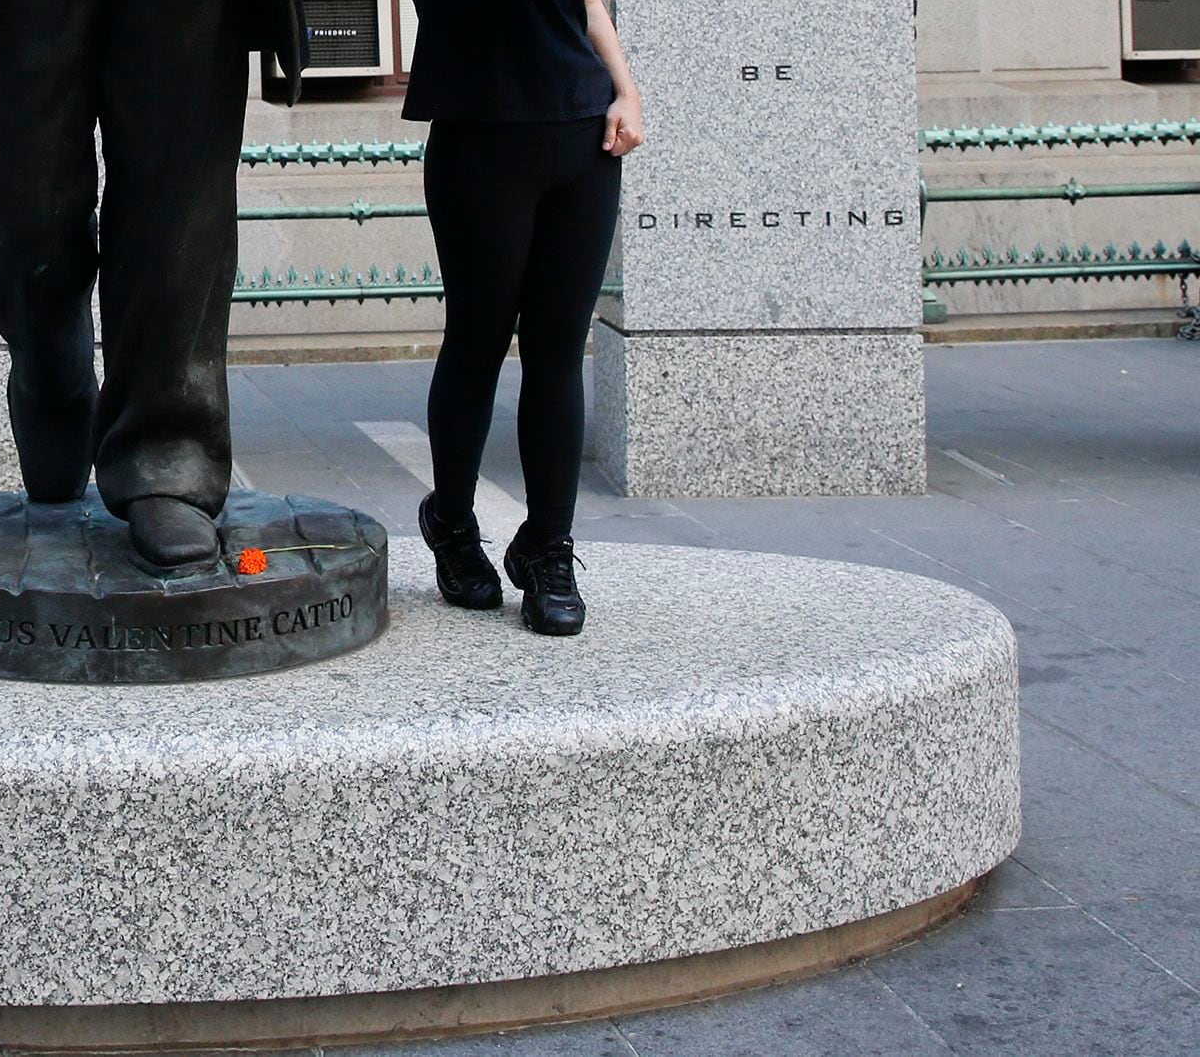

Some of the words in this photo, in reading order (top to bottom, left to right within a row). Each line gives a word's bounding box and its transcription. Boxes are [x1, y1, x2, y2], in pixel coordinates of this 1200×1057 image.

[313, 29, 358, 37] FRIEDRICH
[741, 64, 792, 81] BE
[638, 209, 905, 231] DIRECTING
[47, 616, 263, 652] VALENTINE
[271, 593, 353, 636] CATTO
